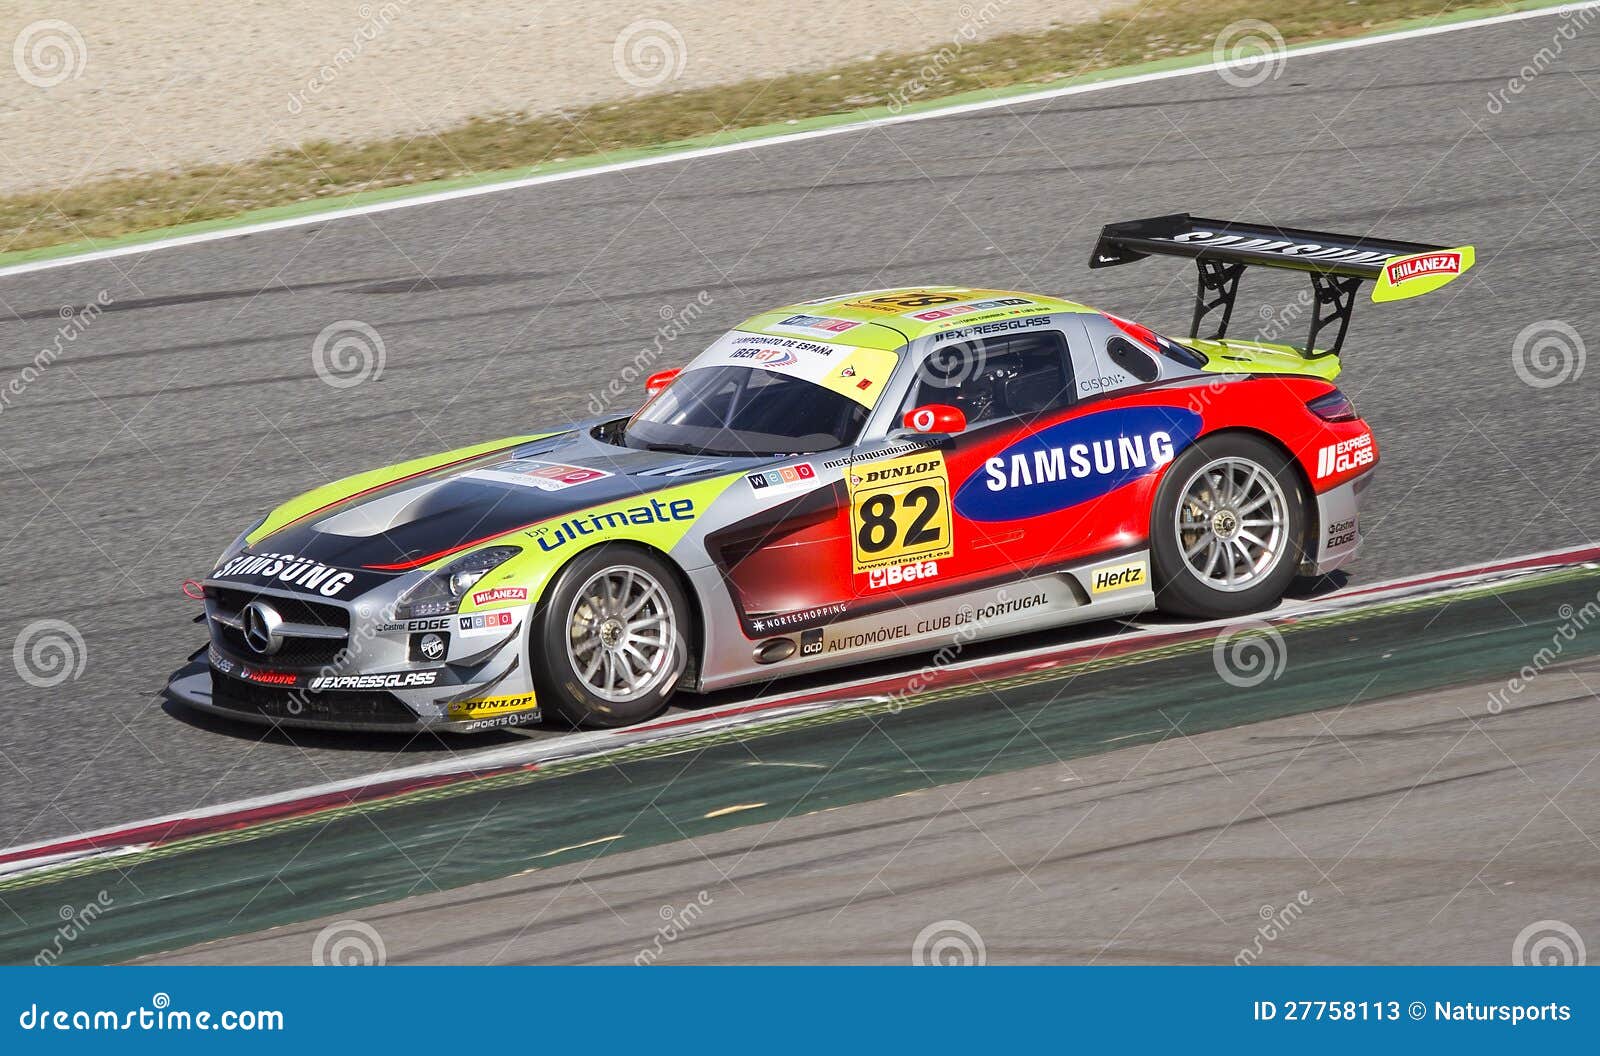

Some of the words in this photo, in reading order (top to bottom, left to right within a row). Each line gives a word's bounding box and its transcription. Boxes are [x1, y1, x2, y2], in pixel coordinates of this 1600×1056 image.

[1154, 231, 1396, 266] SAMSUN
[1391, 256, 1458, 281] MILANEZA
[945, 316, 1051, 340] EXPRESSGLASS
[781, 339, 795, 348] DE
[796, 342, 834, 357] ESPAÑA
[1336, 433, 1371, 454] EXPRESS
[985, 431, 1175, 492] SAMSUNG
[1336, 446, 1374, 473] GLASS
[866, 460, 940, 483] DUNLOP
[537, 498, 695, 551] ultimate
[858, 486, 941, 553] 82
[525, 527, 549, 538] bp
[1327, 530, 1356, 548] EDGE
[857, 550, 950, 571] www.gtsport.es
[213, 553, 354, 596] SAMSUNG
[887, 561, 938, 585] Beta
[1096, 566, 1142, 589] Hertz
[475, 588, 526, 604] MILANEZA
[407, 618, 450, 632] EDGE
[767, 603, 847, 628] NORTESHOPPING
[828, 626, 910, 652] AUTOMÓVEL
[917, 616, 951, 634] CLUB
[955, 610, 973, 626] DE
[976, 593, 1048, 620] PORTUGAL
[321, 672, 437, 688] EXPRESSGLASS
[464, 696, 532, 711] DUNLOP
